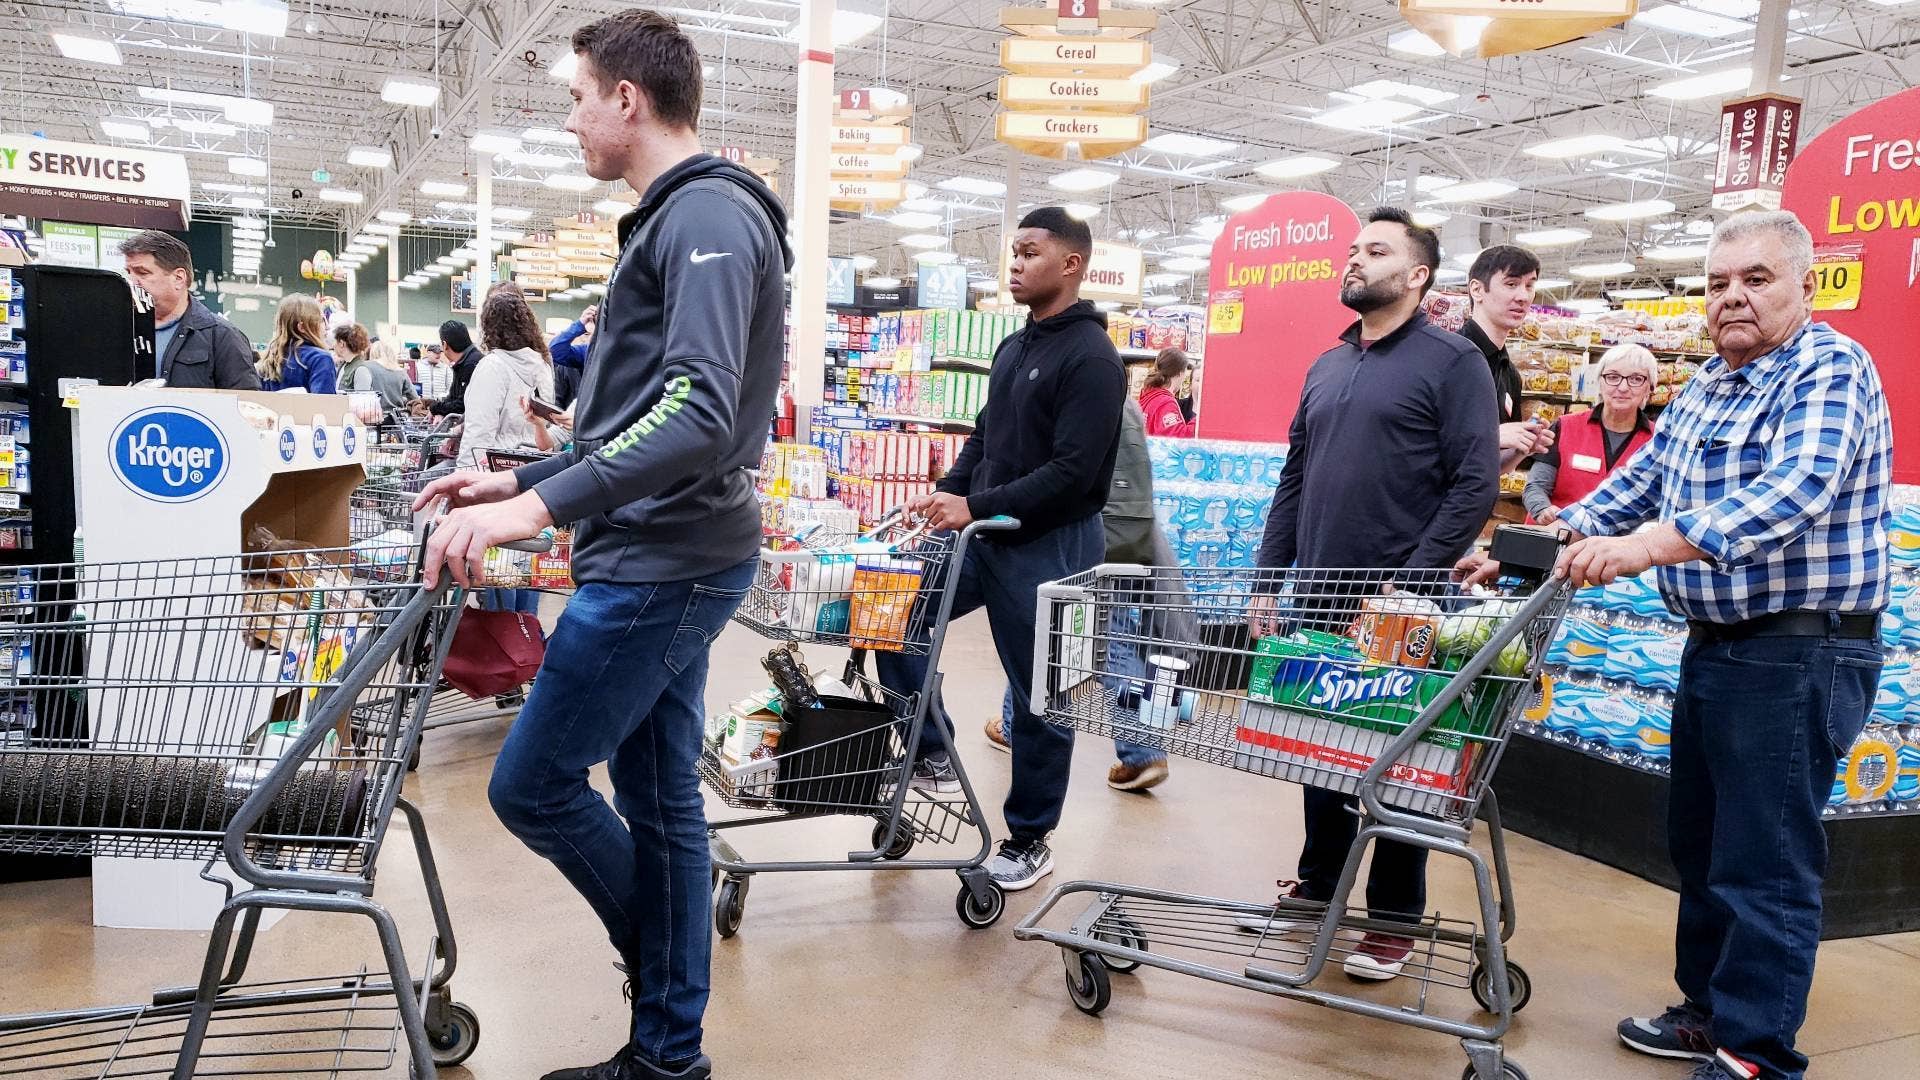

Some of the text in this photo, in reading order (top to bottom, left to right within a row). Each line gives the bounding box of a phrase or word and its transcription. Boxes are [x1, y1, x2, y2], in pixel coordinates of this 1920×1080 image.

[1071, 0, 1086, 16] 8
[1056, 45, 1097, 59] Cereal
[1049, 81, 1100, 96] Cookies
[850, 91, 861, 109] 9
[1045, 118, 1099, 134] Crackers
[838, 129, 871, 142] Baking
[725, 147, 740, 161] 10
[1731, 107, 1758, 186] Service
[1770, 108, 1793, 187] Service
[29, 151, 146, 182] SERVICES
[838, 156, 870, 167] Coffee
[9, 186, 30, 194] MONEY
[30, 188, 53, 196] ORDERS
[58, 191, 79, 199] MONEY
[79, 193, 111, 202] TRANSFERS
[116, 195, 128, 204] BILL
[144, 200, 170, 208] RETURNS
[838, 184, 868, 195] Spices
[580, 212, 592, 223] 12
[536, 233, 546, 242] 13
[1234, 214, 1334, 252] Fresh food.
[926, 264, 958, 294] 4X
[1228, 256, 1338, 289] Low prices.
[128, 423, 215, 487] Kroger
[1406, 623, 1433, 659] Fanta
[1311, 668, 1414, 710] Sprite
